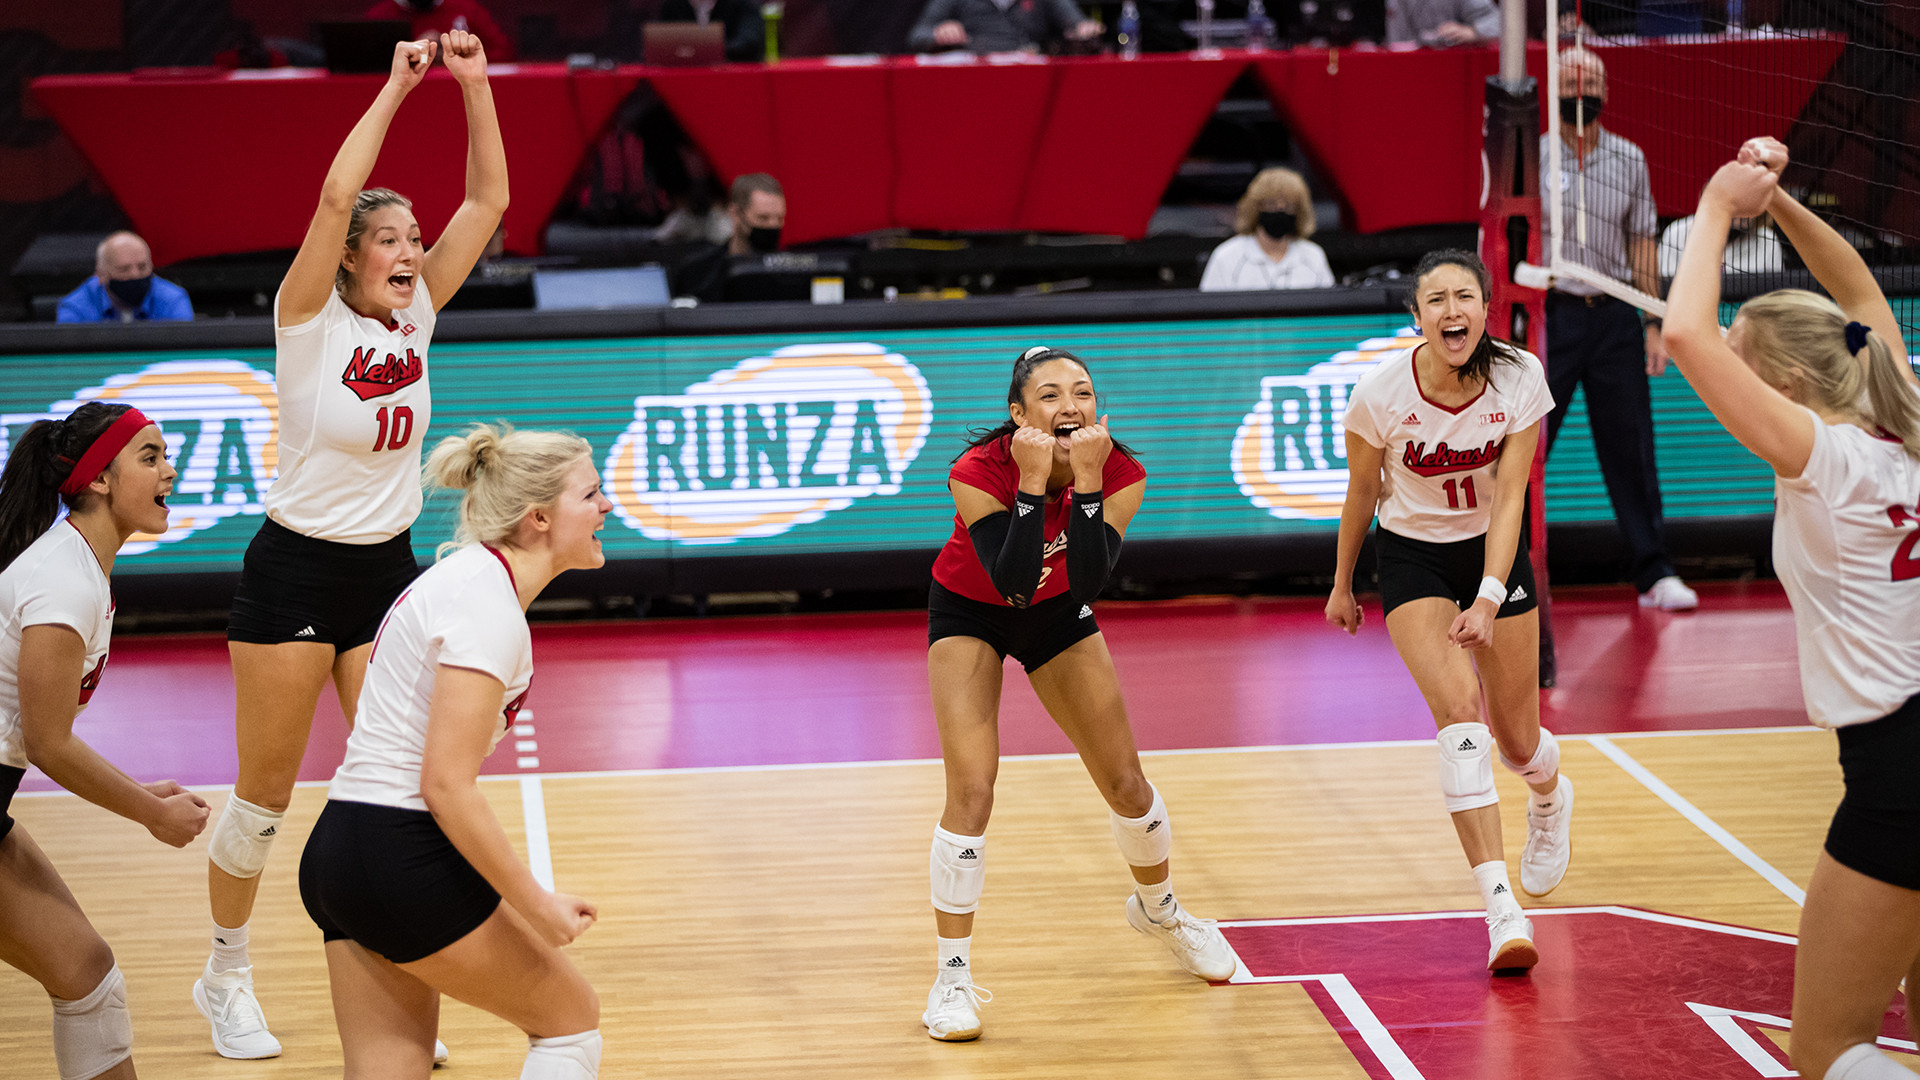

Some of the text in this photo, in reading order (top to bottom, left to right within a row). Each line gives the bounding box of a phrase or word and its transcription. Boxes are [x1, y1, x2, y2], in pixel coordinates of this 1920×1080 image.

[372, 406, 413, 452] 10
[645, 399, 895, 492] RUNZA
[1402, 440, 1503, 471] Nebrask
[1016, 500, 1034, 511] adidas
[1081, 501, 1101, 510] adidas
[1442, 475, 1477, 509] 11
